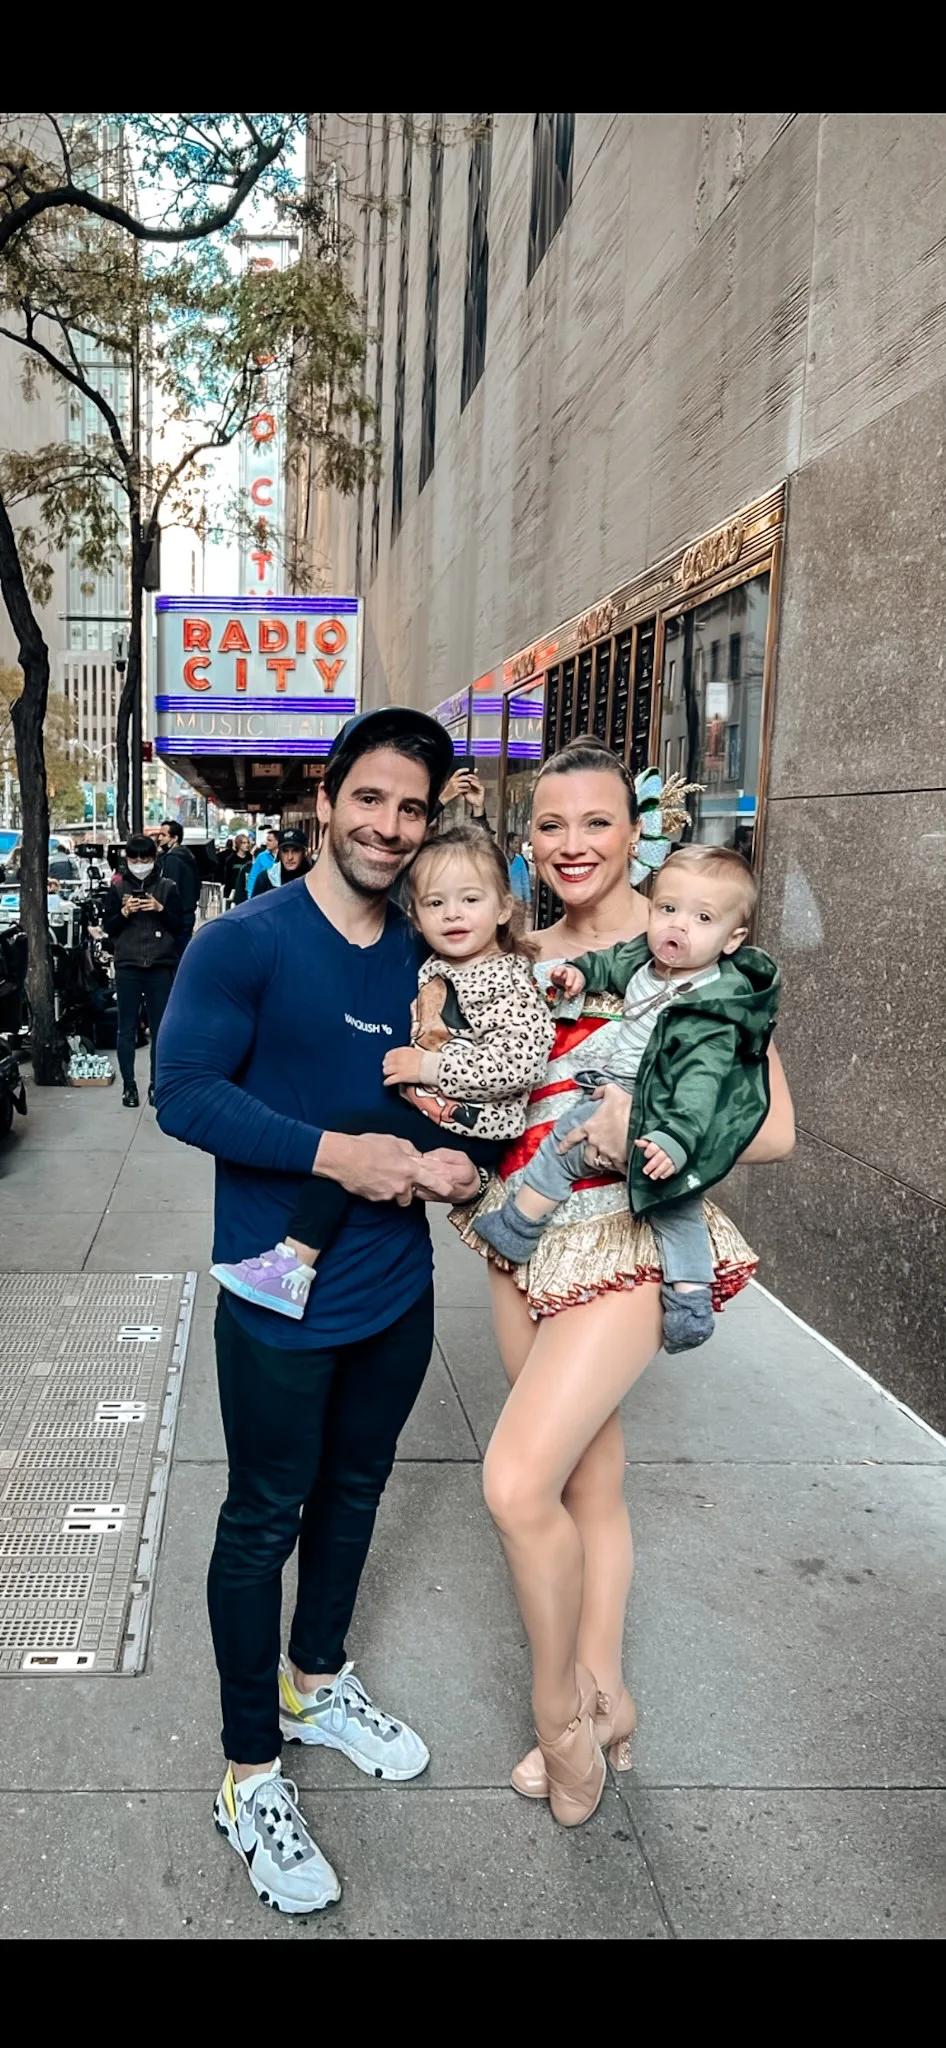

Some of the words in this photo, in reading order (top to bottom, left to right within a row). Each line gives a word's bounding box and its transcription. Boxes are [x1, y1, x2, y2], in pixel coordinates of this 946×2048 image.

[249, 476, 274, 595] CIT
[183, 618, 347, 655] RADIO
[183, 656, 346, 692] CITY
[175, 713, 264, 736] MUSIC
